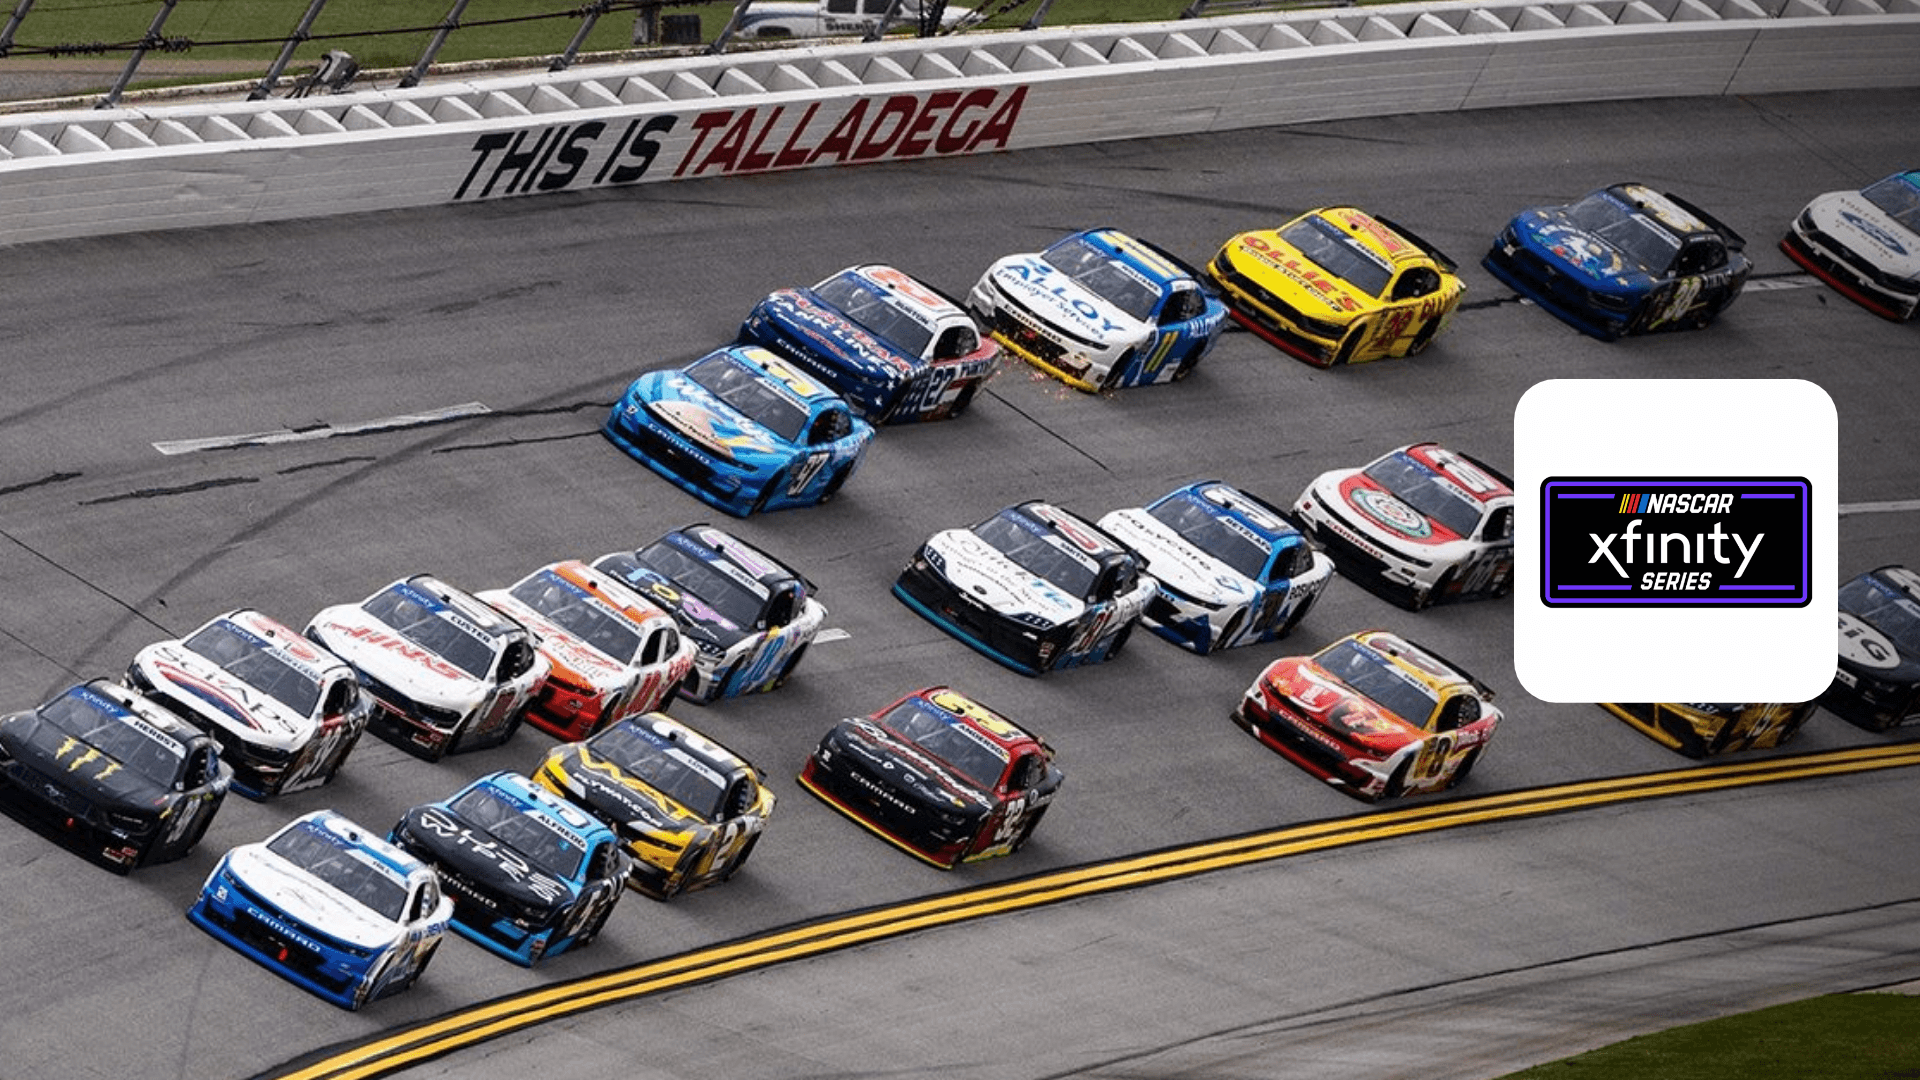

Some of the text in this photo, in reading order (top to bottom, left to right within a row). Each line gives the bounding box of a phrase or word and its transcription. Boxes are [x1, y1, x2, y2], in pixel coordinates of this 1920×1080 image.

[454, 84, 1031, 199] THIS IS TALLADEGA
[1241, 235, 1364, 313] OLLIE'S
[893, 299, 931, 326] BURTON
[995, 268, 1106, 342] Employer Services
[1003, 262, 1126, 333] ALLOY
[771, 293, 832, 331] TANK
[832, 330, 900, 380] LINES
[776, 337, 838, 380] CAMARO
[920, 365, 962, 414] 27
[648, 421, 711, 466] CAMARO
[400, 586, 434, 608] xfinity
[450, 614, 492, 644] CUSTER
[81, 691, 119, 714] xfinity
[133, 720, 178, 750] HERBST
[487, 785, 524, 807] xfinity
[850, 770, 917, 815] CAMARO
[537, 814, 587, 848] ALFREDO
[247, 906, 321, 953] CAMARO
